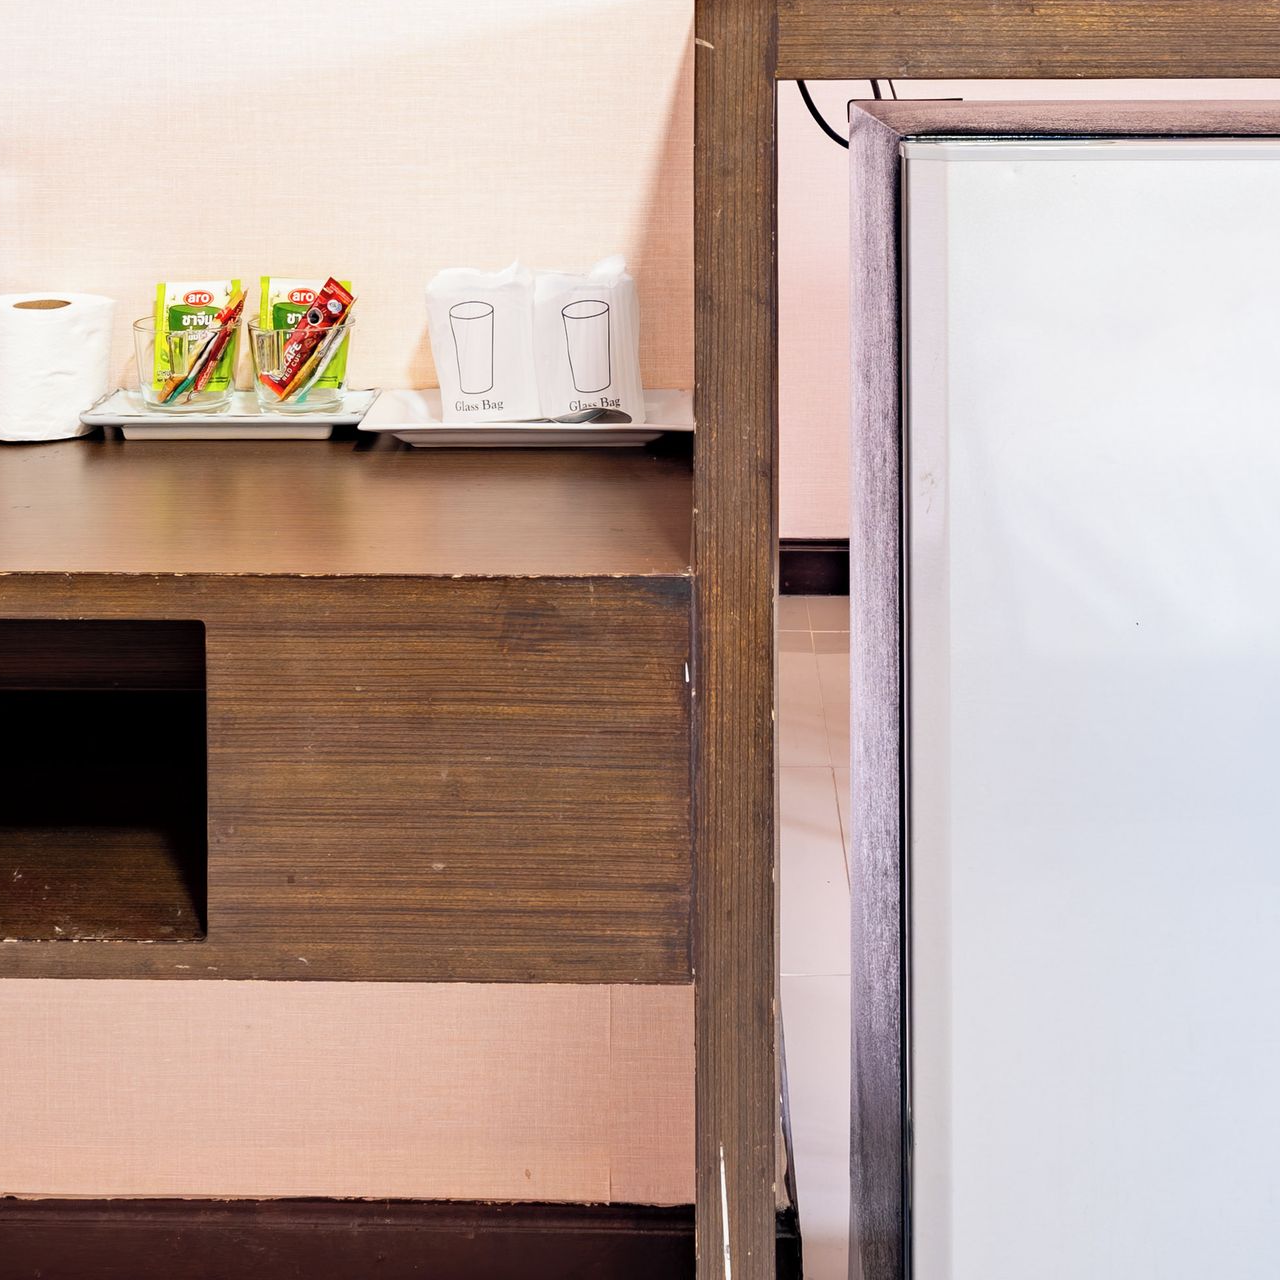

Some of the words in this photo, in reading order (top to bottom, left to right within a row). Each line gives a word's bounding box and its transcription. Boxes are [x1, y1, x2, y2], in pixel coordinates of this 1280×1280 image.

[188, 293, 210, 303] aro
[292, 291, 315, 302] aro
[455, 400, 479, 412] Glass
[482, 399, 504, 411] Bag
[600, 397, 621, 409] Bag
